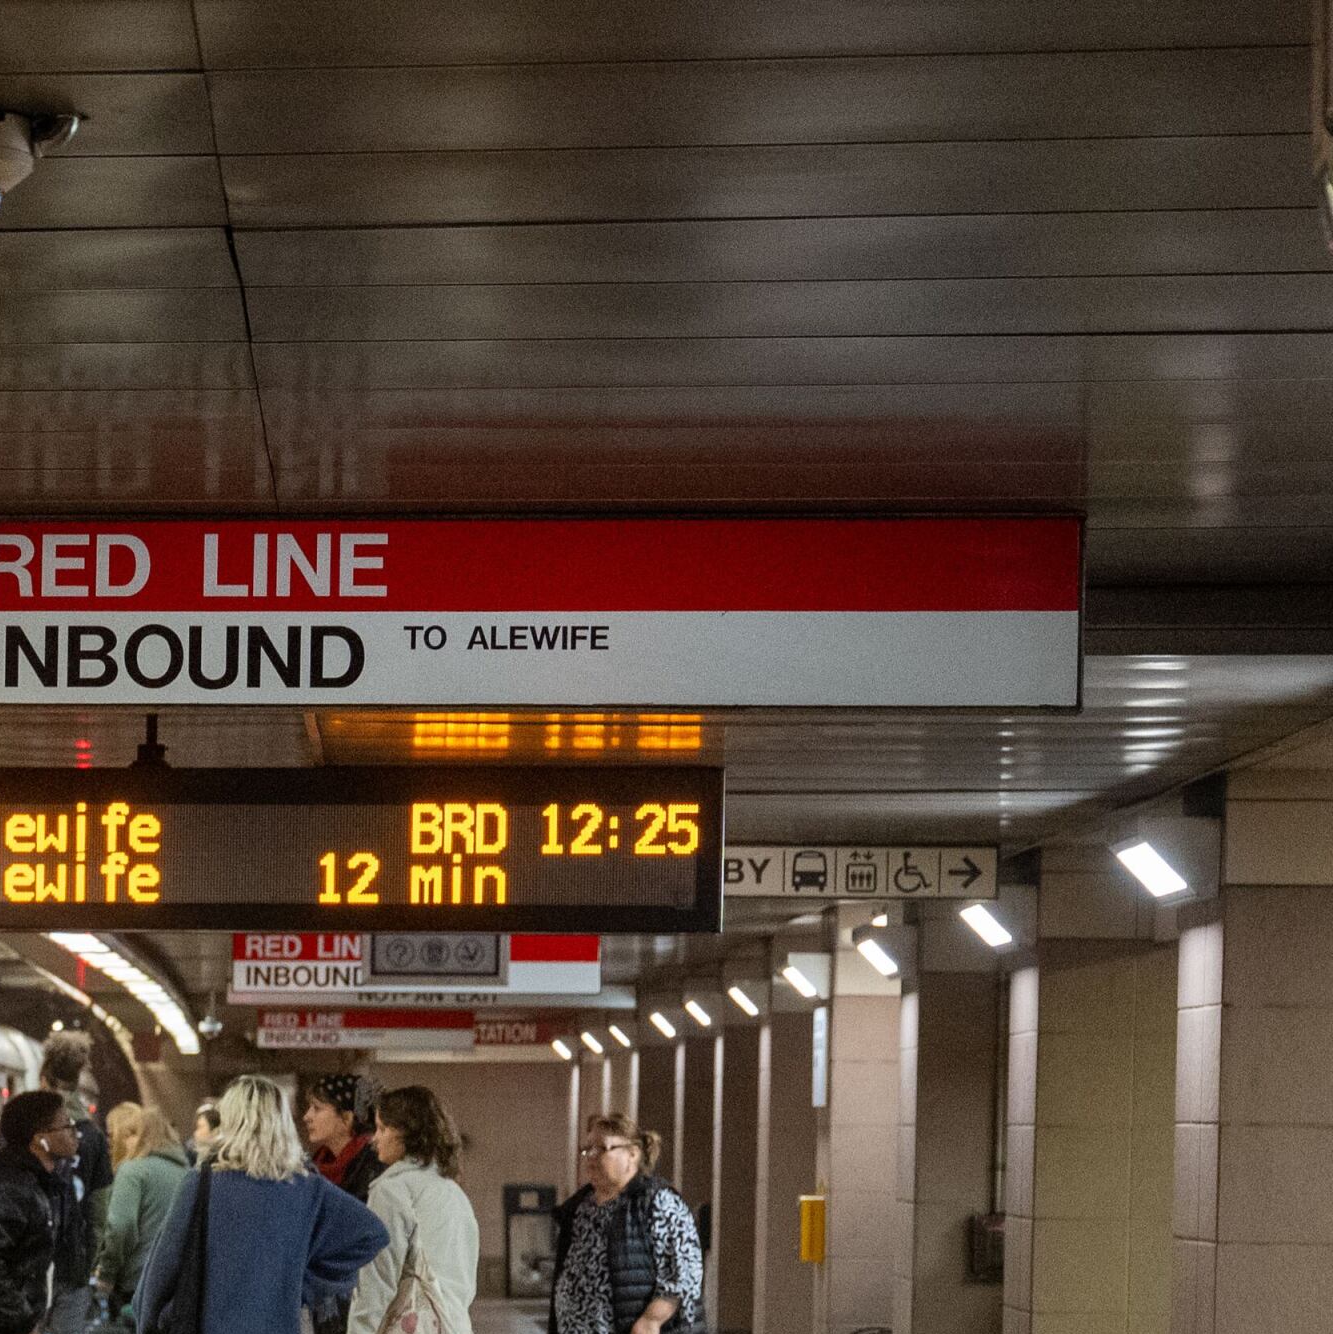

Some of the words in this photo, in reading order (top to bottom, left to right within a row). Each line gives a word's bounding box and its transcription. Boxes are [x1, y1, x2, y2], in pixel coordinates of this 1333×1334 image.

[203, 534, 389, 597] LINE
[403, 625, 447, 651] TO
[467, 625, 610, 650] ALEWIFE
[410, 802, 508, 855] BRD
[541, 803, 699, 855] 12:25
[318, 853, 380, 904] 12
[409, 856, 507, 904] min
[724, 858, 771, 884] BY
[245, 933, 303, 959] RED
[316, 933, 362, 959] LIN
[475, 1023, 538, 1042] TATION
